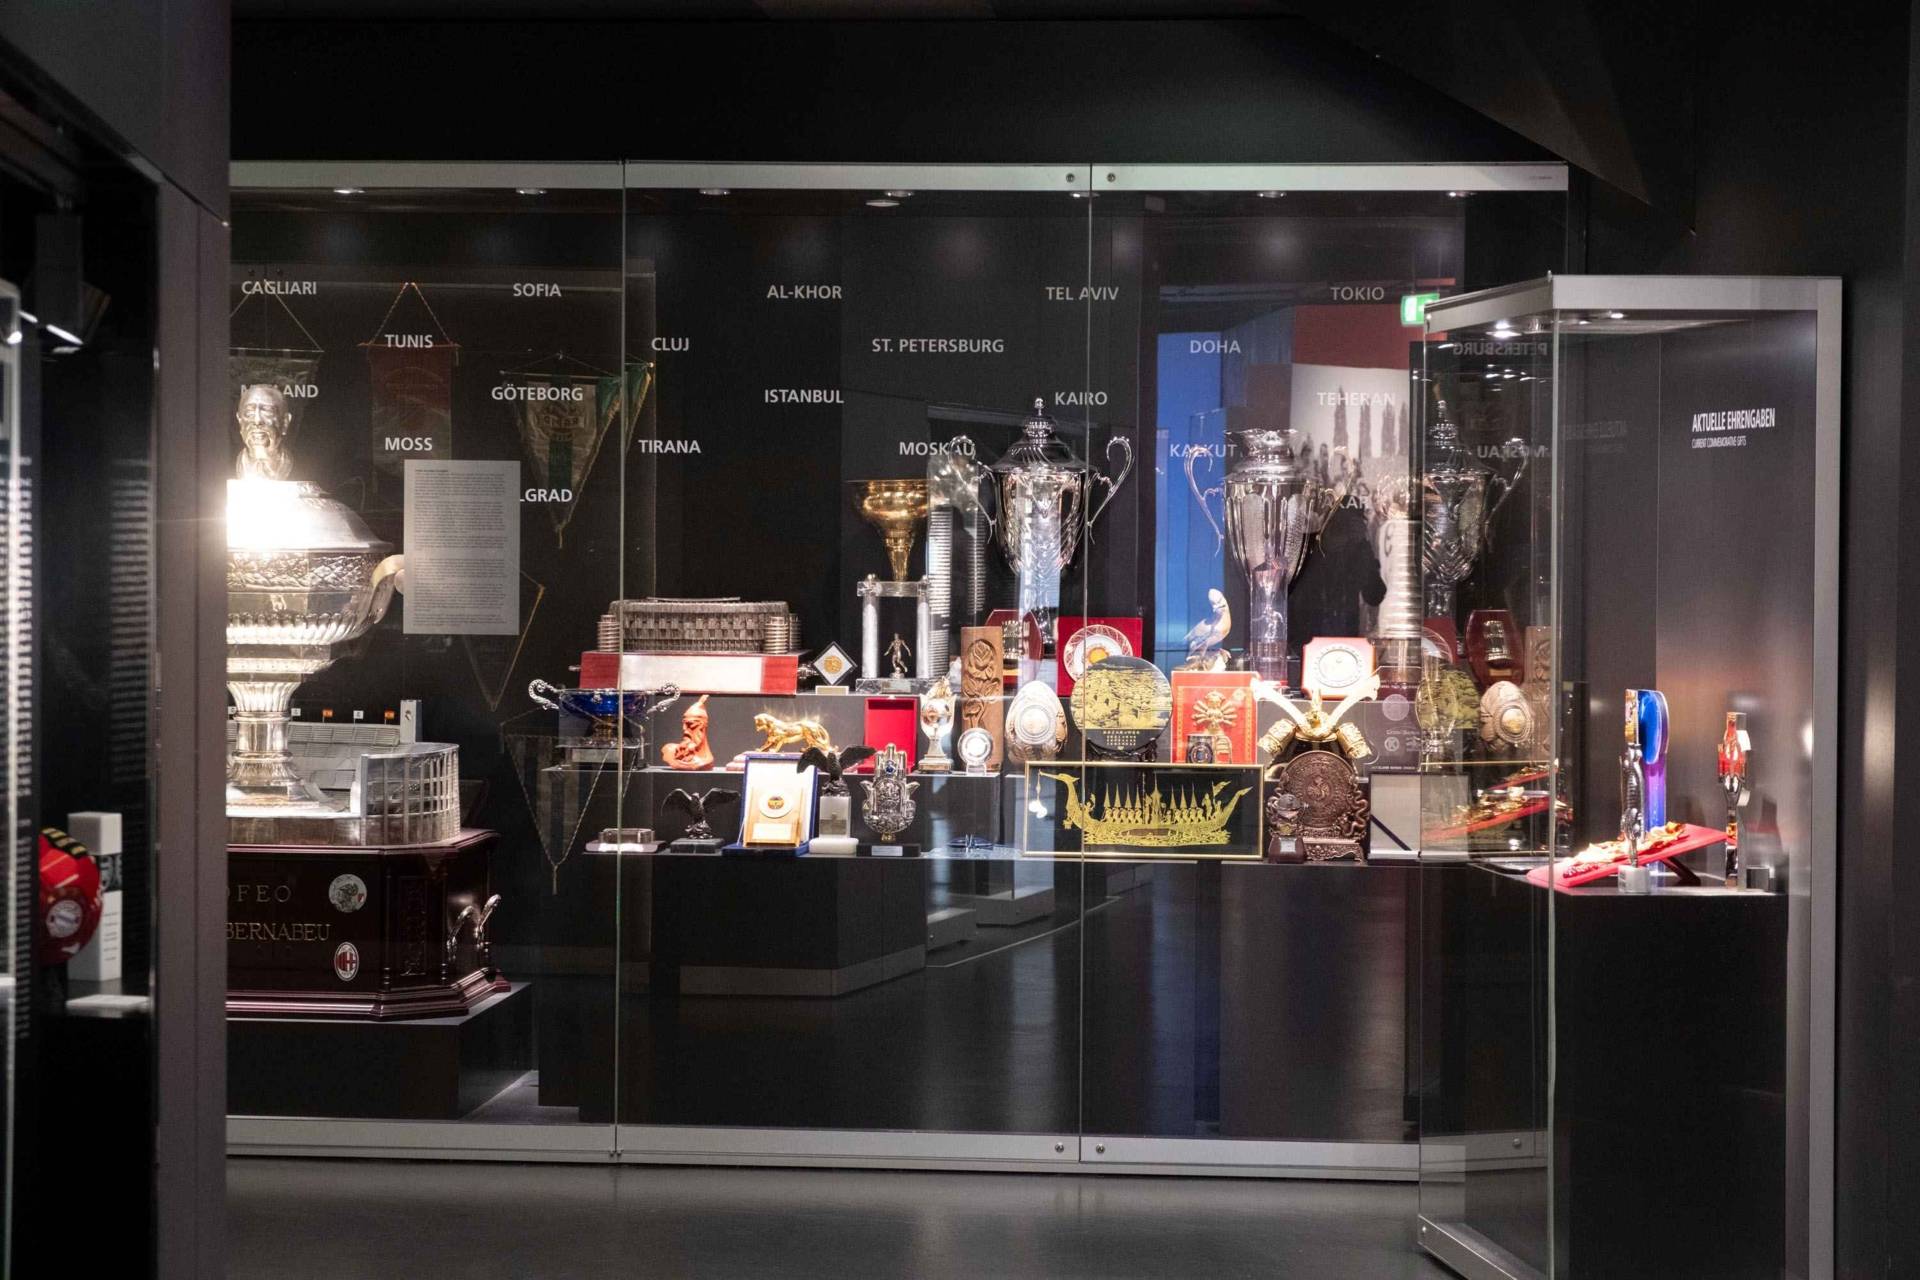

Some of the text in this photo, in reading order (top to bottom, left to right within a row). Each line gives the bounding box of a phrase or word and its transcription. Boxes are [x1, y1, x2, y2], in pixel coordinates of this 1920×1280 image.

[241, 281, 317, 296] CAGLIARI
[513, 283, 562, 298] SOFIA
[767, 285, 843, 300] AL-KHOR
[1046, 287, 1119, 301] TEL AVIV
[1331, 287, 1385, 301] TOKIO
[385, 334, 433, 349] TUNIS
[651, 337, 690, 353] CLUJ
[872, 338, 1004, 353] ST. PETERSBURG
[1190, 340, 1241, 354] DOHA
[491, 384, 583, 401] GÖTEBORG
[765, 389, 844, 404] ISTANBUL
[1055, 392, 1108, 406] KAIRO
[1317, 392, 1395, 406] TEHERAN
[1692, 408, 1775, 432] AKTUELLE EHRENGABEN
[384, 437, 433, 451] MOSS
[638, 440, 701, 454] TIRANA
[900, 442, 974, 456] MOSKAU
